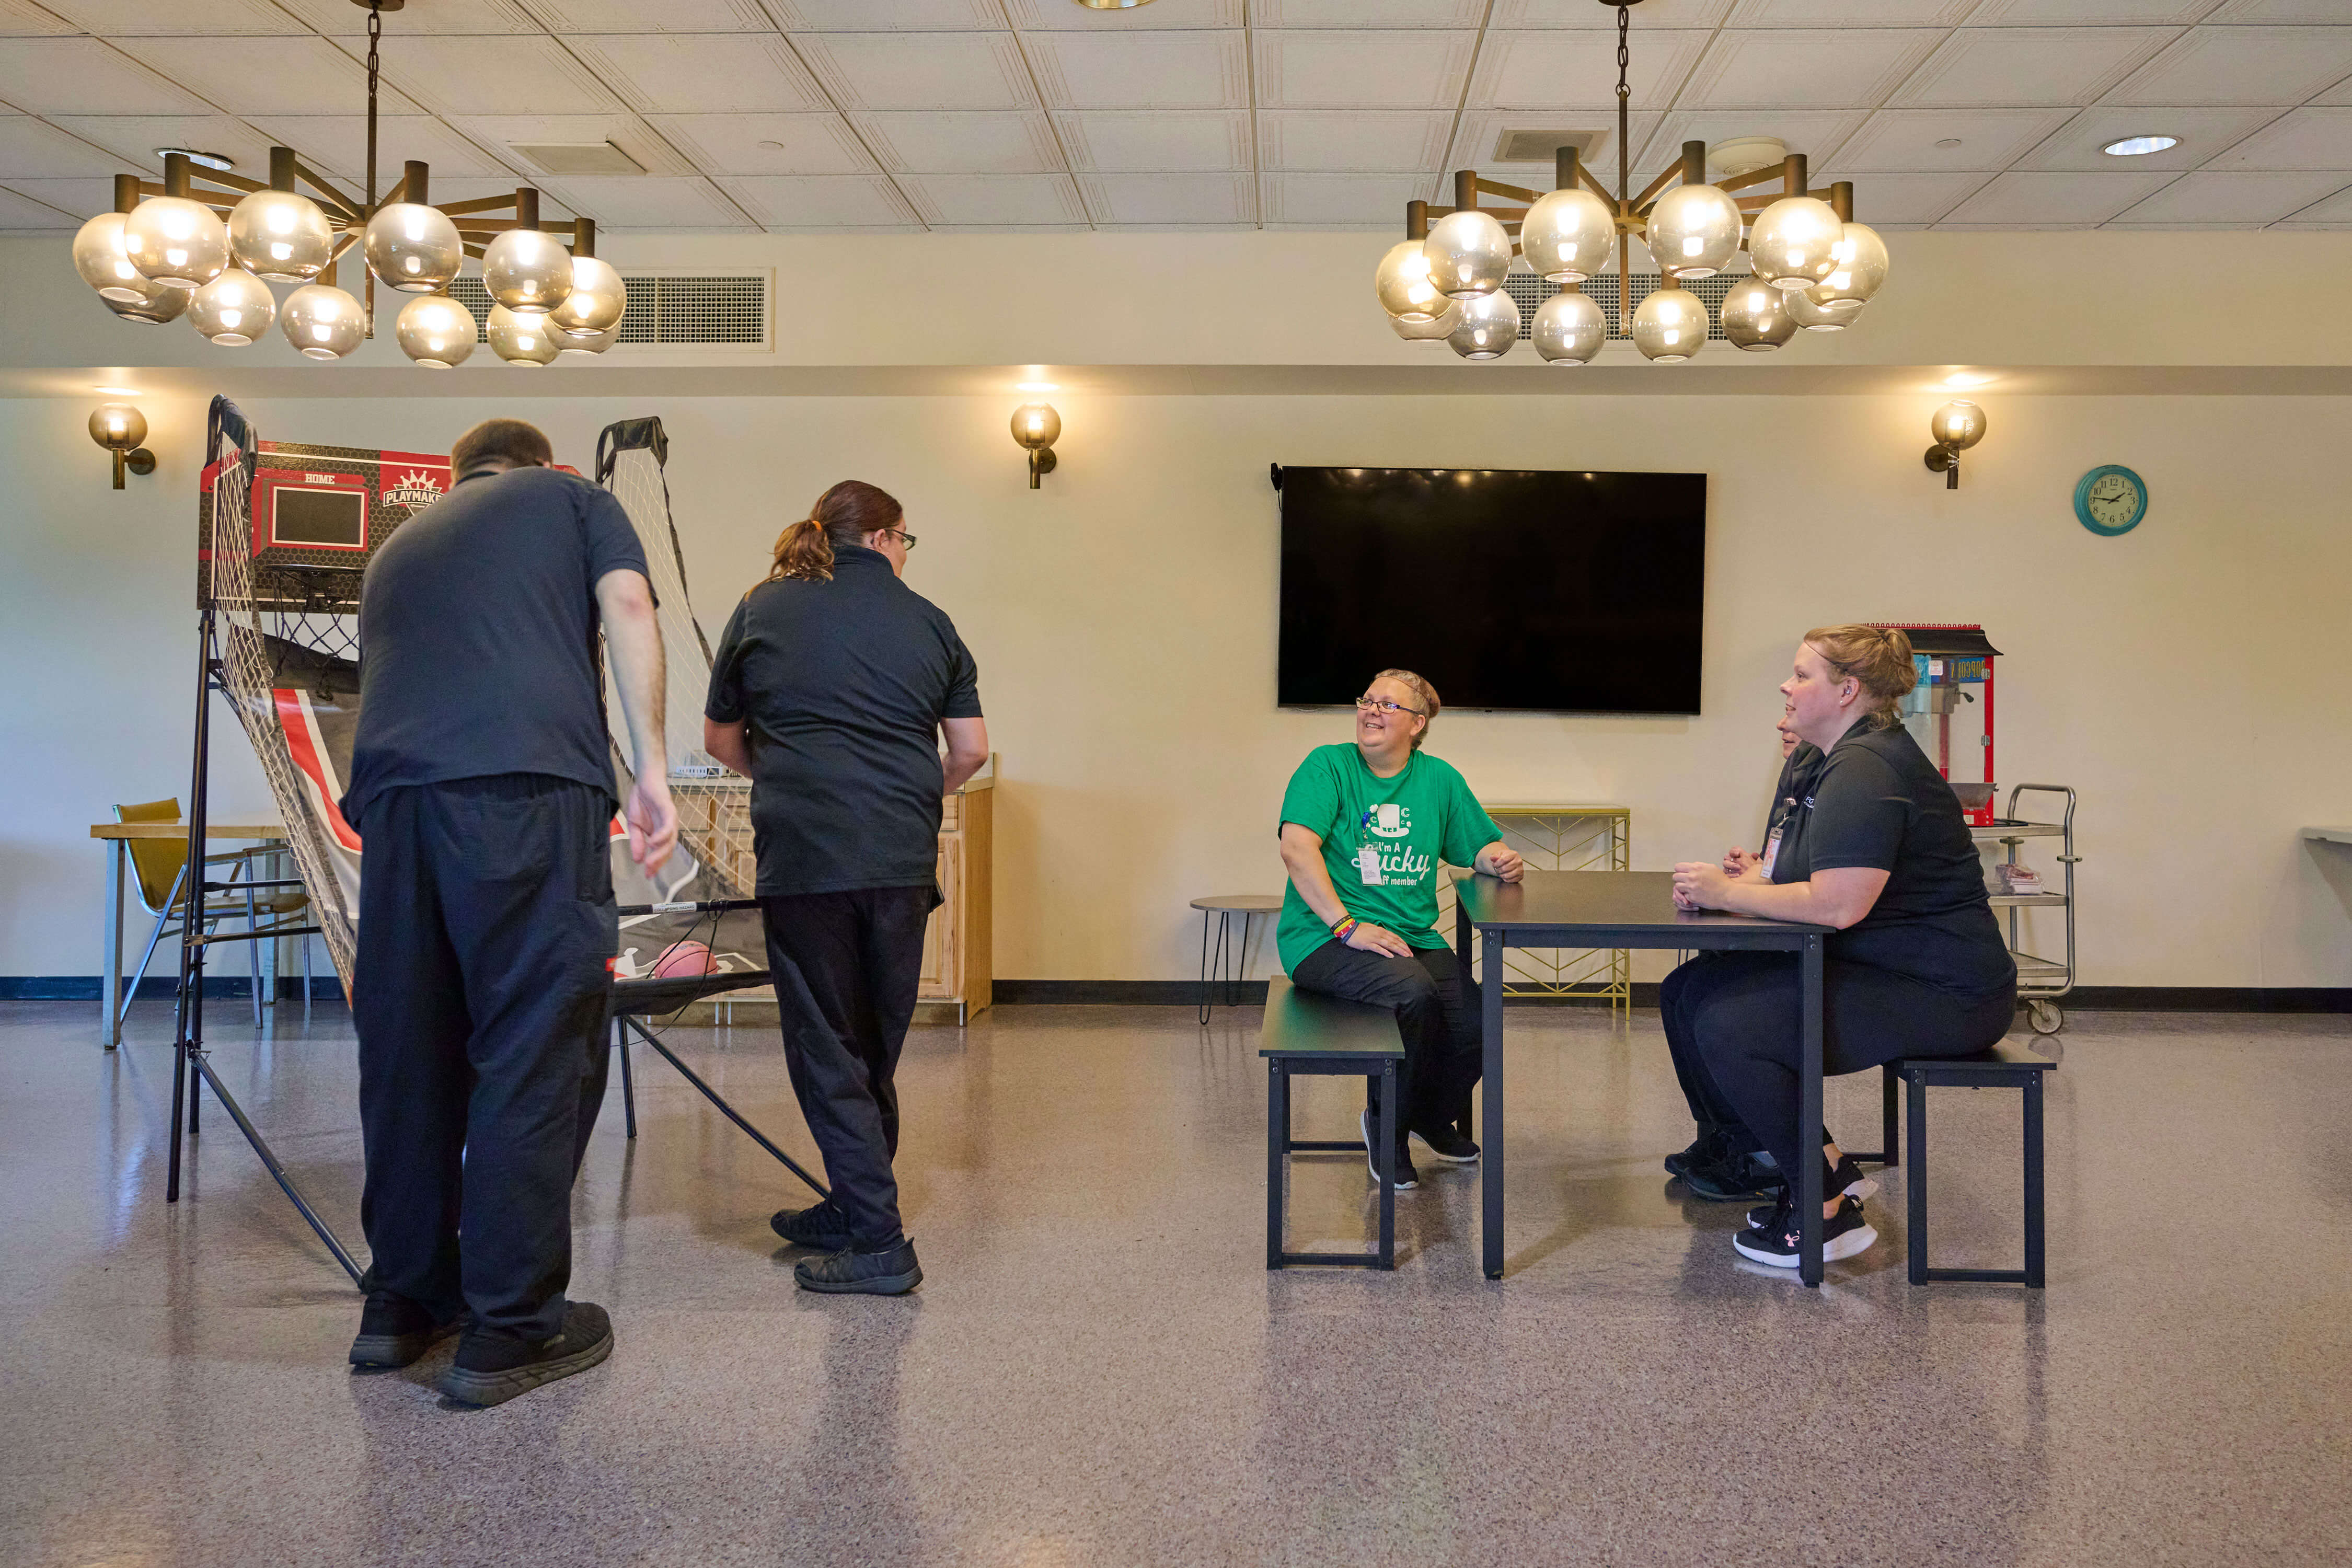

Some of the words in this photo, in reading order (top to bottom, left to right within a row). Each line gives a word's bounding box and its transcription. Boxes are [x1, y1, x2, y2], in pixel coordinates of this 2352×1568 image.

[305, 474, 335, 485] HOME
[2110, 478, 2118, 486] 12
[2126, 506, 2130, 514] 4
[1379, 842, 1391, 852] I'm
[1394, 843, 1400, 852] A
[1351, 846, 1430, 880] ucky
[1391, 875, 1417, 885] member
